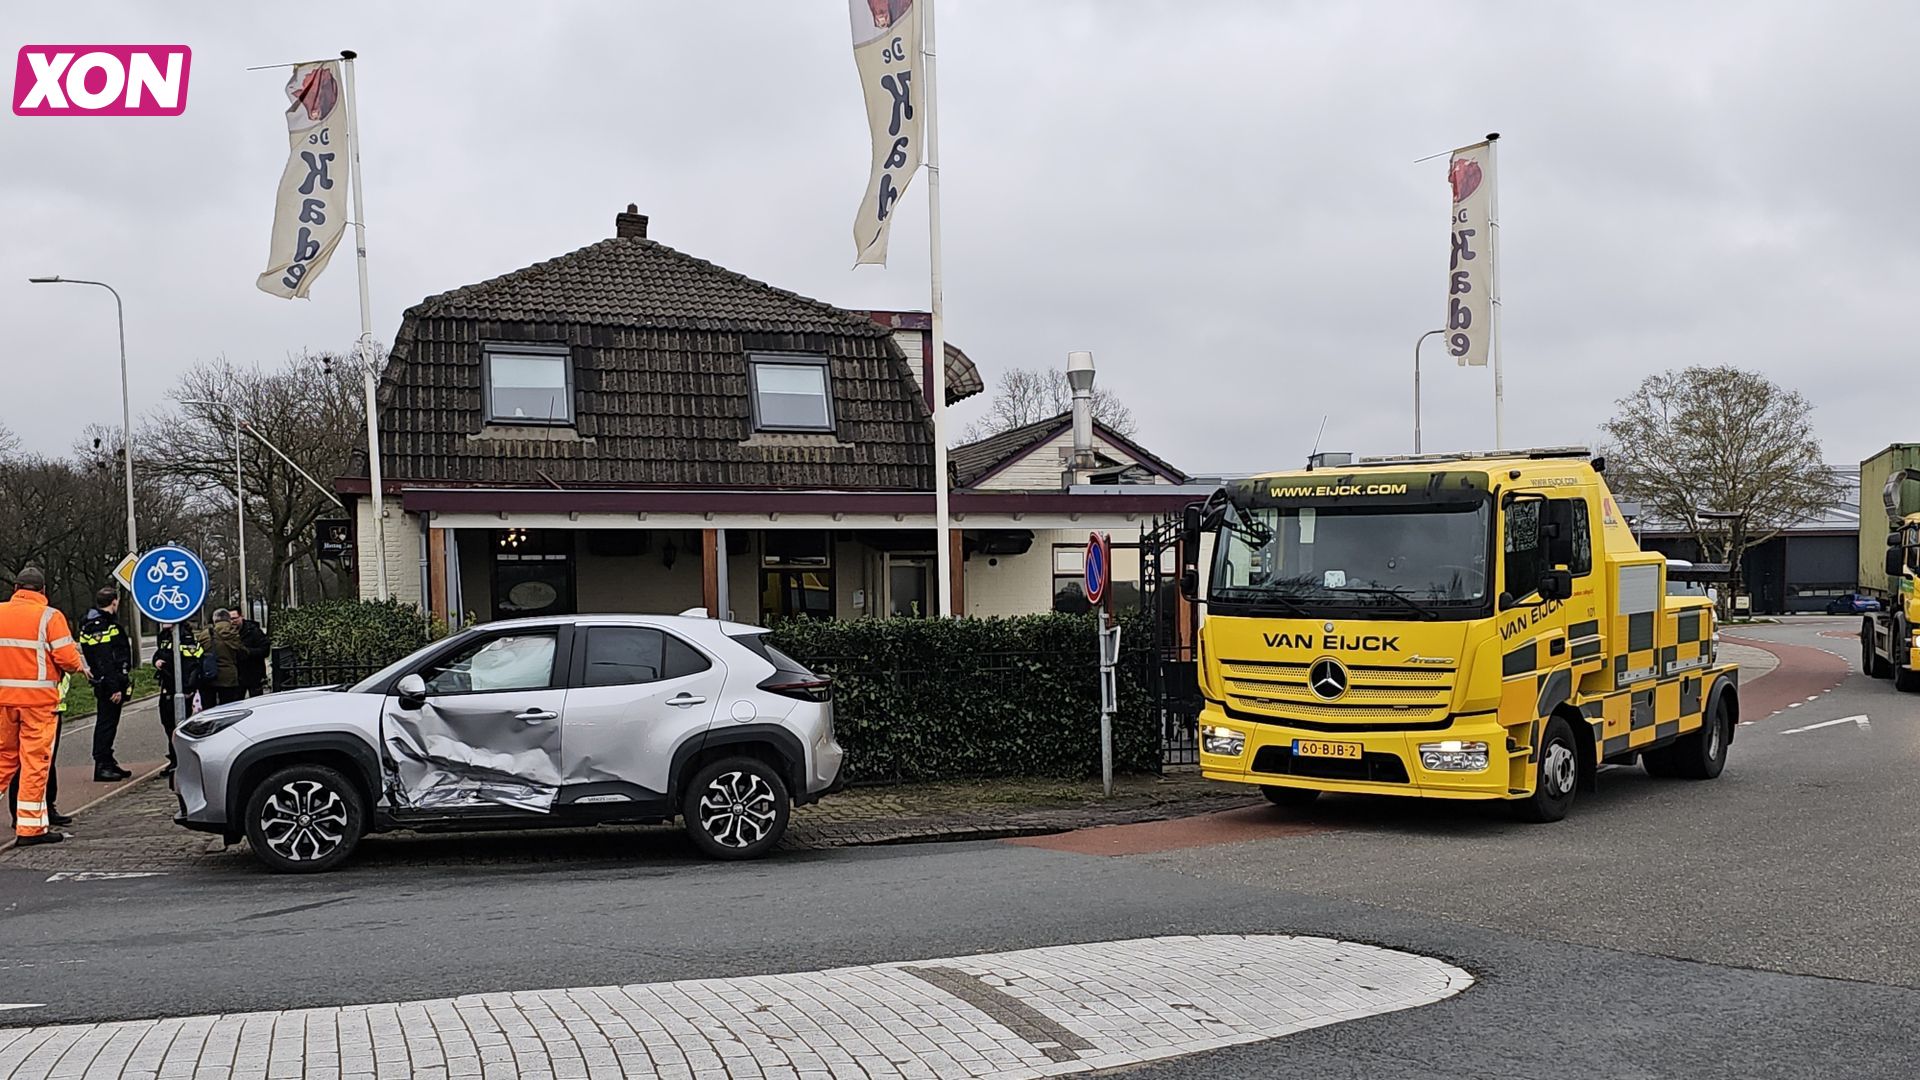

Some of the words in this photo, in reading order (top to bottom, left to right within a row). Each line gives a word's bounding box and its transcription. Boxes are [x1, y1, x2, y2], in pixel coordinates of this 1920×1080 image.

[1270, 484, 1407, 498] WWW.EIJCK.COM
[1500, 614, 1527, 640] VAN
[1262, 633, 1313, 649] VAN
[1323, 635, 1400, 651] EIJCK
[1301, 742, 1356, 757] 60-BJB-2
